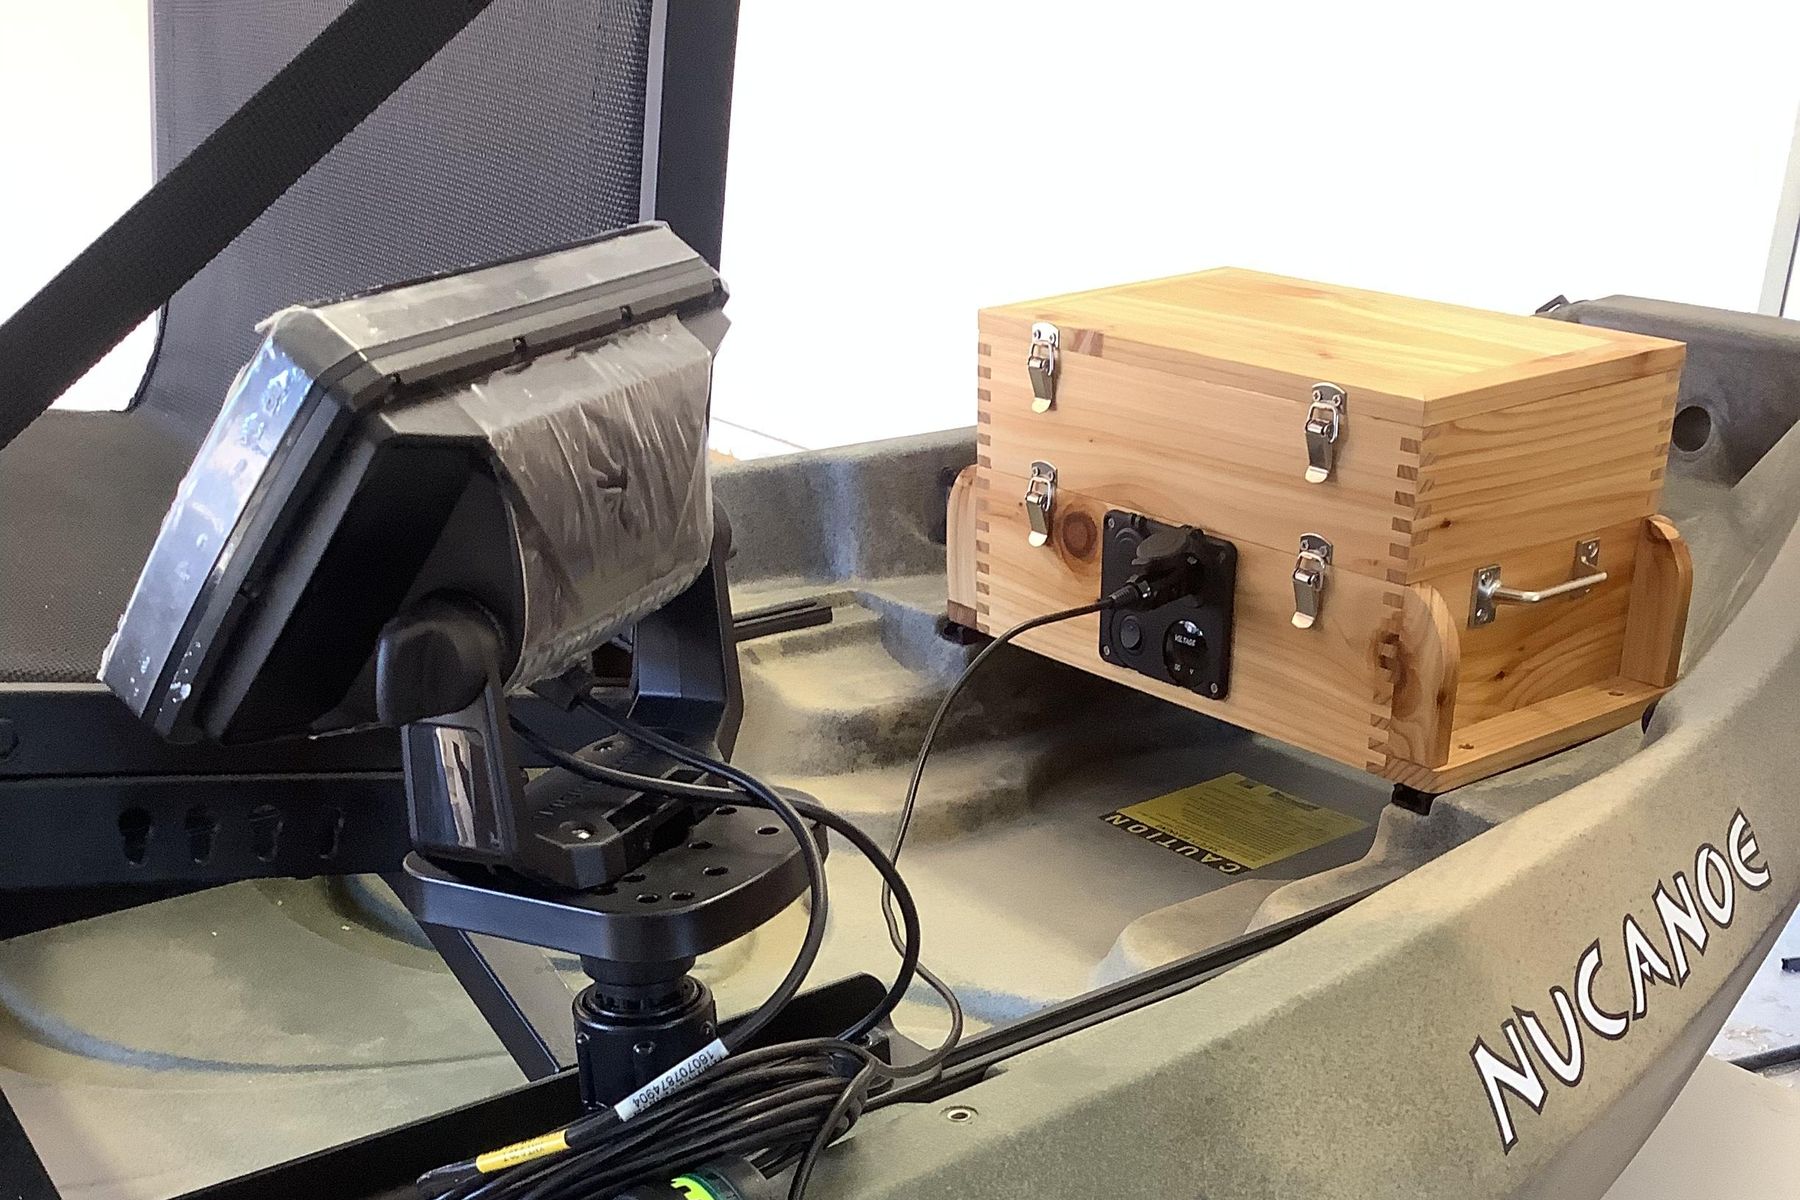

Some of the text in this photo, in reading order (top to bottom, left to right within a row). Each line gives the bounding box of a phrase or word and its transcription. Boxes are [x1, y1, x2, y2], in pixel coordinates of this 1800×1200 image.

[1174, 633, 1196, 647] VOLTAGE
[1104, 814, 1241, 873] CAUTION
[1469, 808, 1772, 1156] NUCANOE
